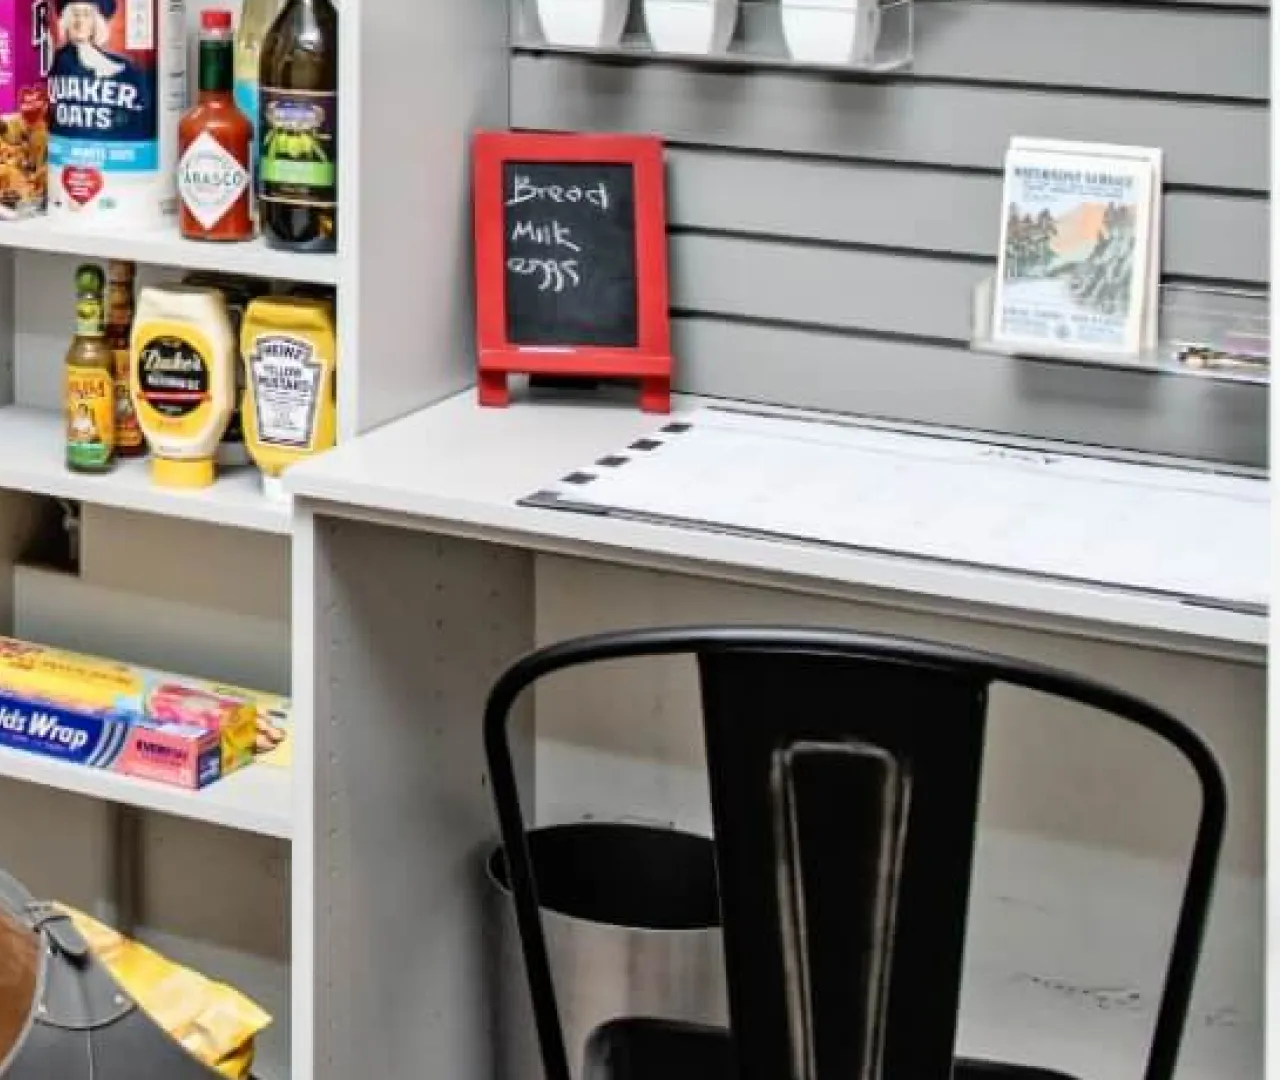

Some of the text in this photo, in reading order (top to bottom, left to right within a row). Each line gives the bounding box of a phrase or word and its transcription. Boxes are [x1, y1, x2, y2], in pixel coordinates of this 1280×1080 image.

[56, 104, 113, 129] OATS
[504, 171, 610, 210] Bread
[512, 220, 582, 252] Milk
[507, 257, 580, 292] eggs
[28, 713, 90, 753] Wrap
